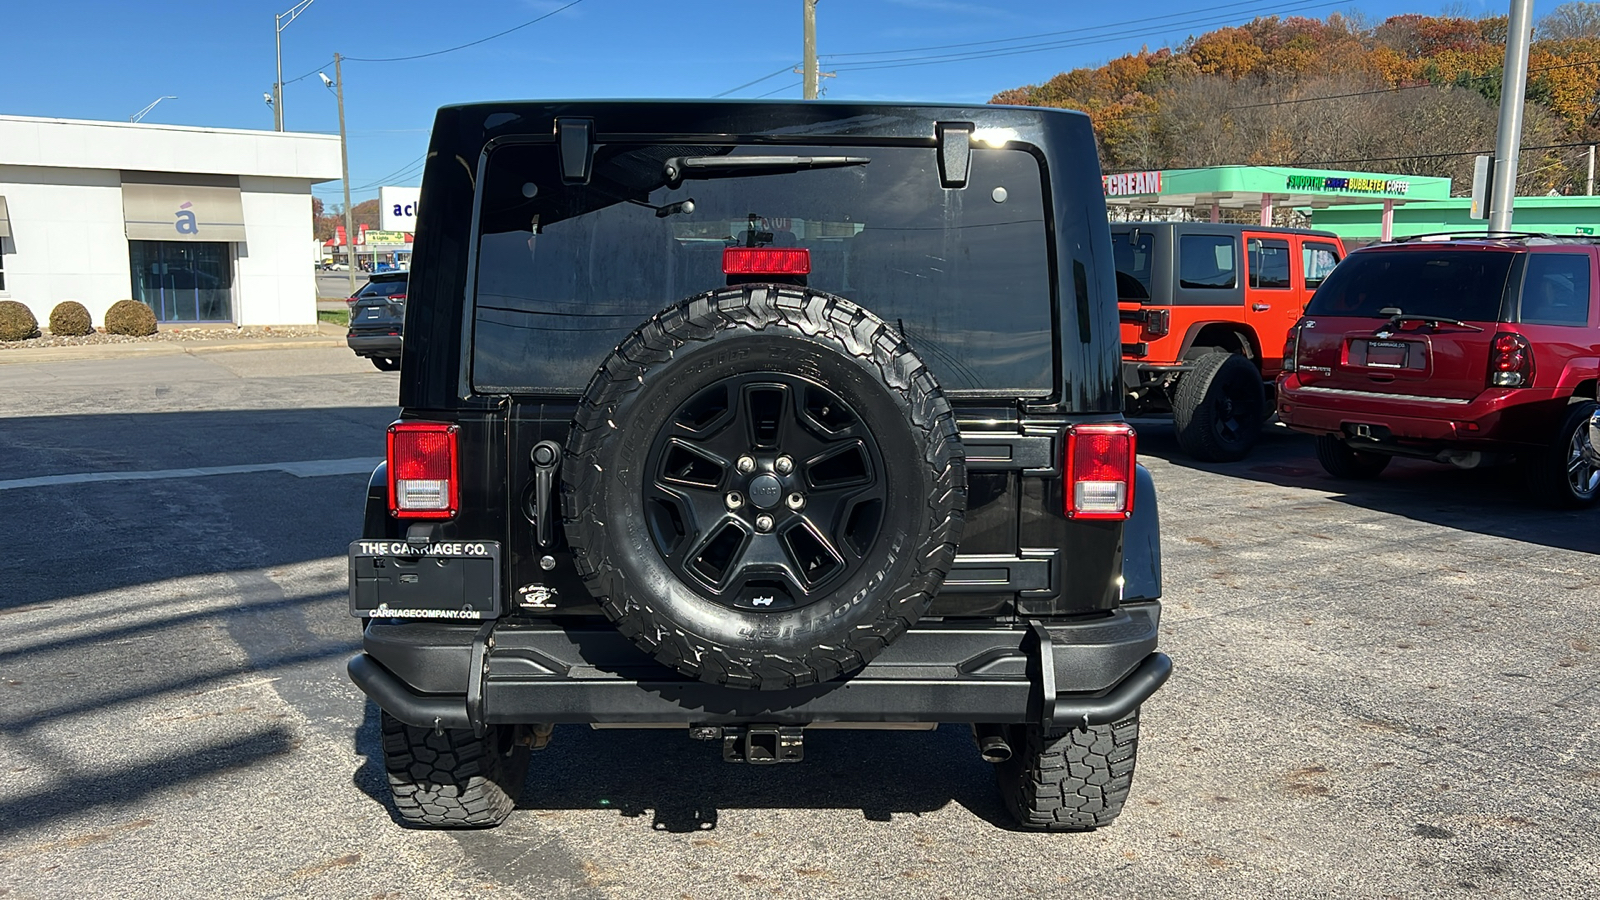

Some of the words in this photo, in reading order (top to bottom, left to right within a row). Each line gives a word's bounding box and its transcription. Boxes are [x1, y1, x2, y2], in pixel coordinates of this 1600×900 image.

[1108, 171, 1161, 196] CREAM
[1289, 175, 1326, 188] SMOOTHIE
[1386, 180, 1409, 192] COFFEE
[752, 486, 777, 497] Jeep
[359, 542, 388, 555] THE
[391, 543, 462, 555] CARRIAGE
[464, 543, 488, 556] CO.
[369, 609, 481, 619] CARRIAGECOMPANY.COM
